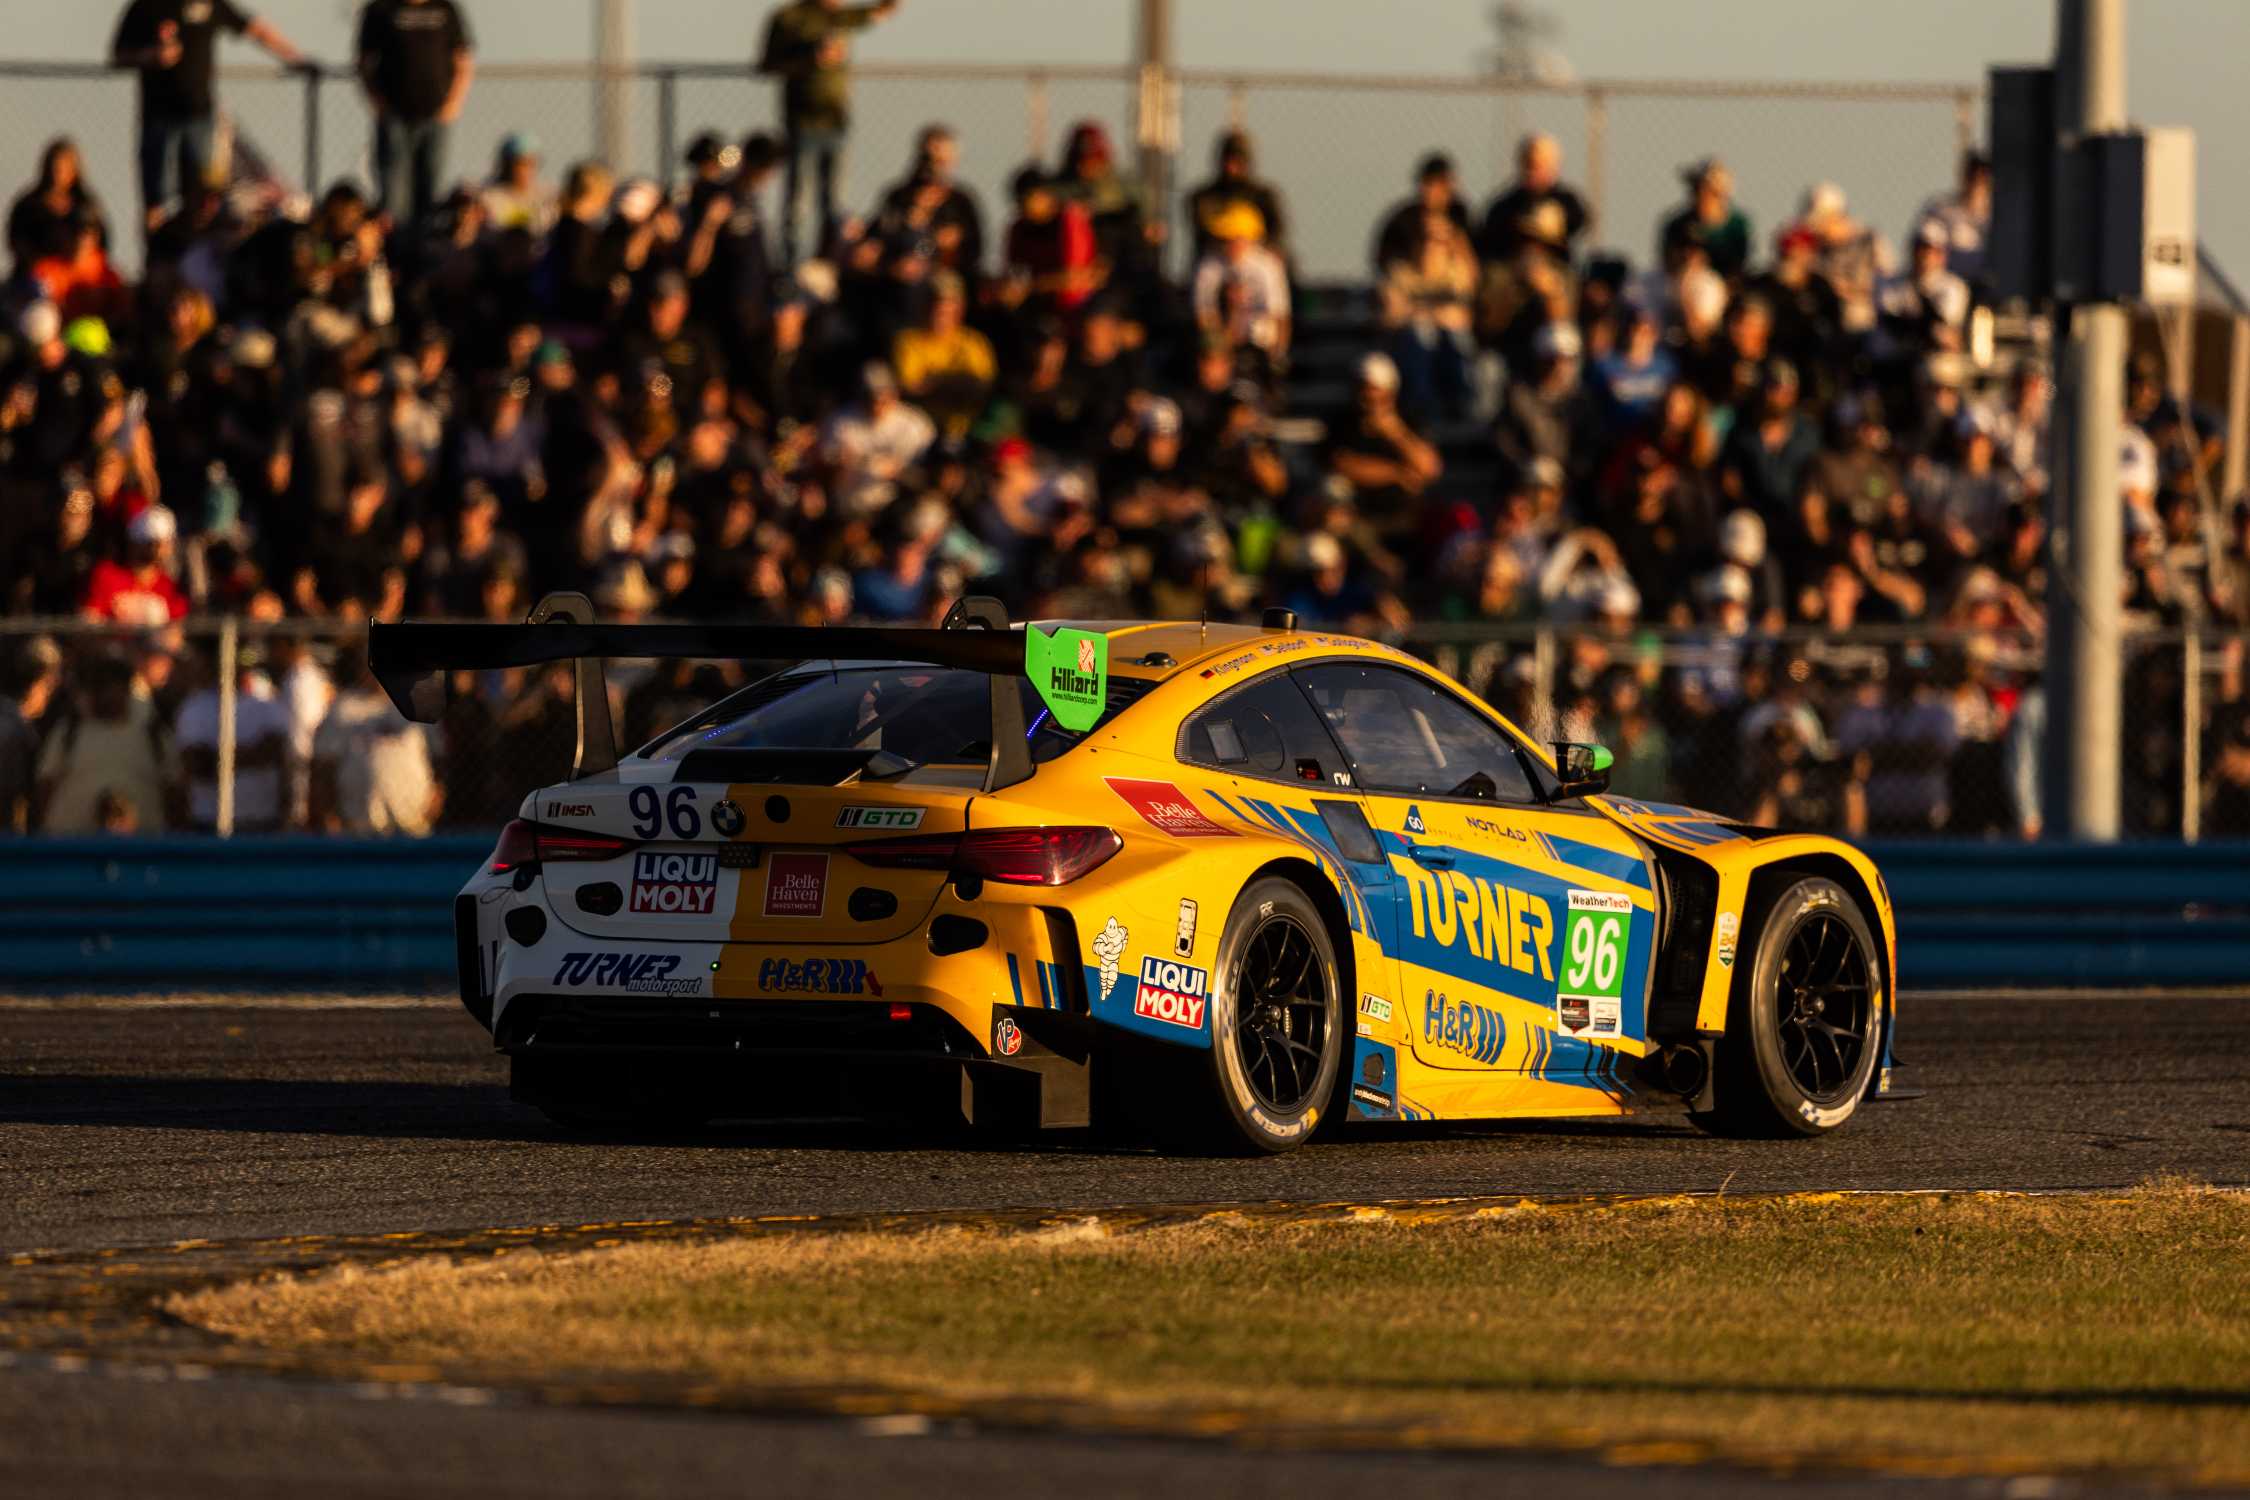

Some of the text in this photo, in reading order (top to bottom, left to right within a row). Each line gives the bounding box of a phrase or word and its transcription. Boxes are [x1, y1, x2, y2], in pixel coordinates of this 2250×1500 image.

[561, 804, 596, 817] IMSA
[629, 785, 701, 839] 96
[861, 811, 919, 826] GTD
[1147, 801, 1199, 819] Belle
[1407, 815, 1424, 831] GO
[637, 855, 717, 883] LIQUI
[784, 873, 820, 889] Belle
[633, 885, 713, 912] MOLY
[771, 886, 819, 902] Haven
[1571, 894, 1630, 909] WeatherTech
[1388, 852, 1554, 982] TURNER
[1567, 915, 1621, 990] 96
[552, 952, 682, 986] TURNER
[759, 958, 826, 993] H&R
[1143, 959, 1205, 996] LIQUI
[626, 976, 704, 997] motorsport
[1139, 988, 1203, 1025] MOLY
[1424, 989, 1477, 1058] H&R
